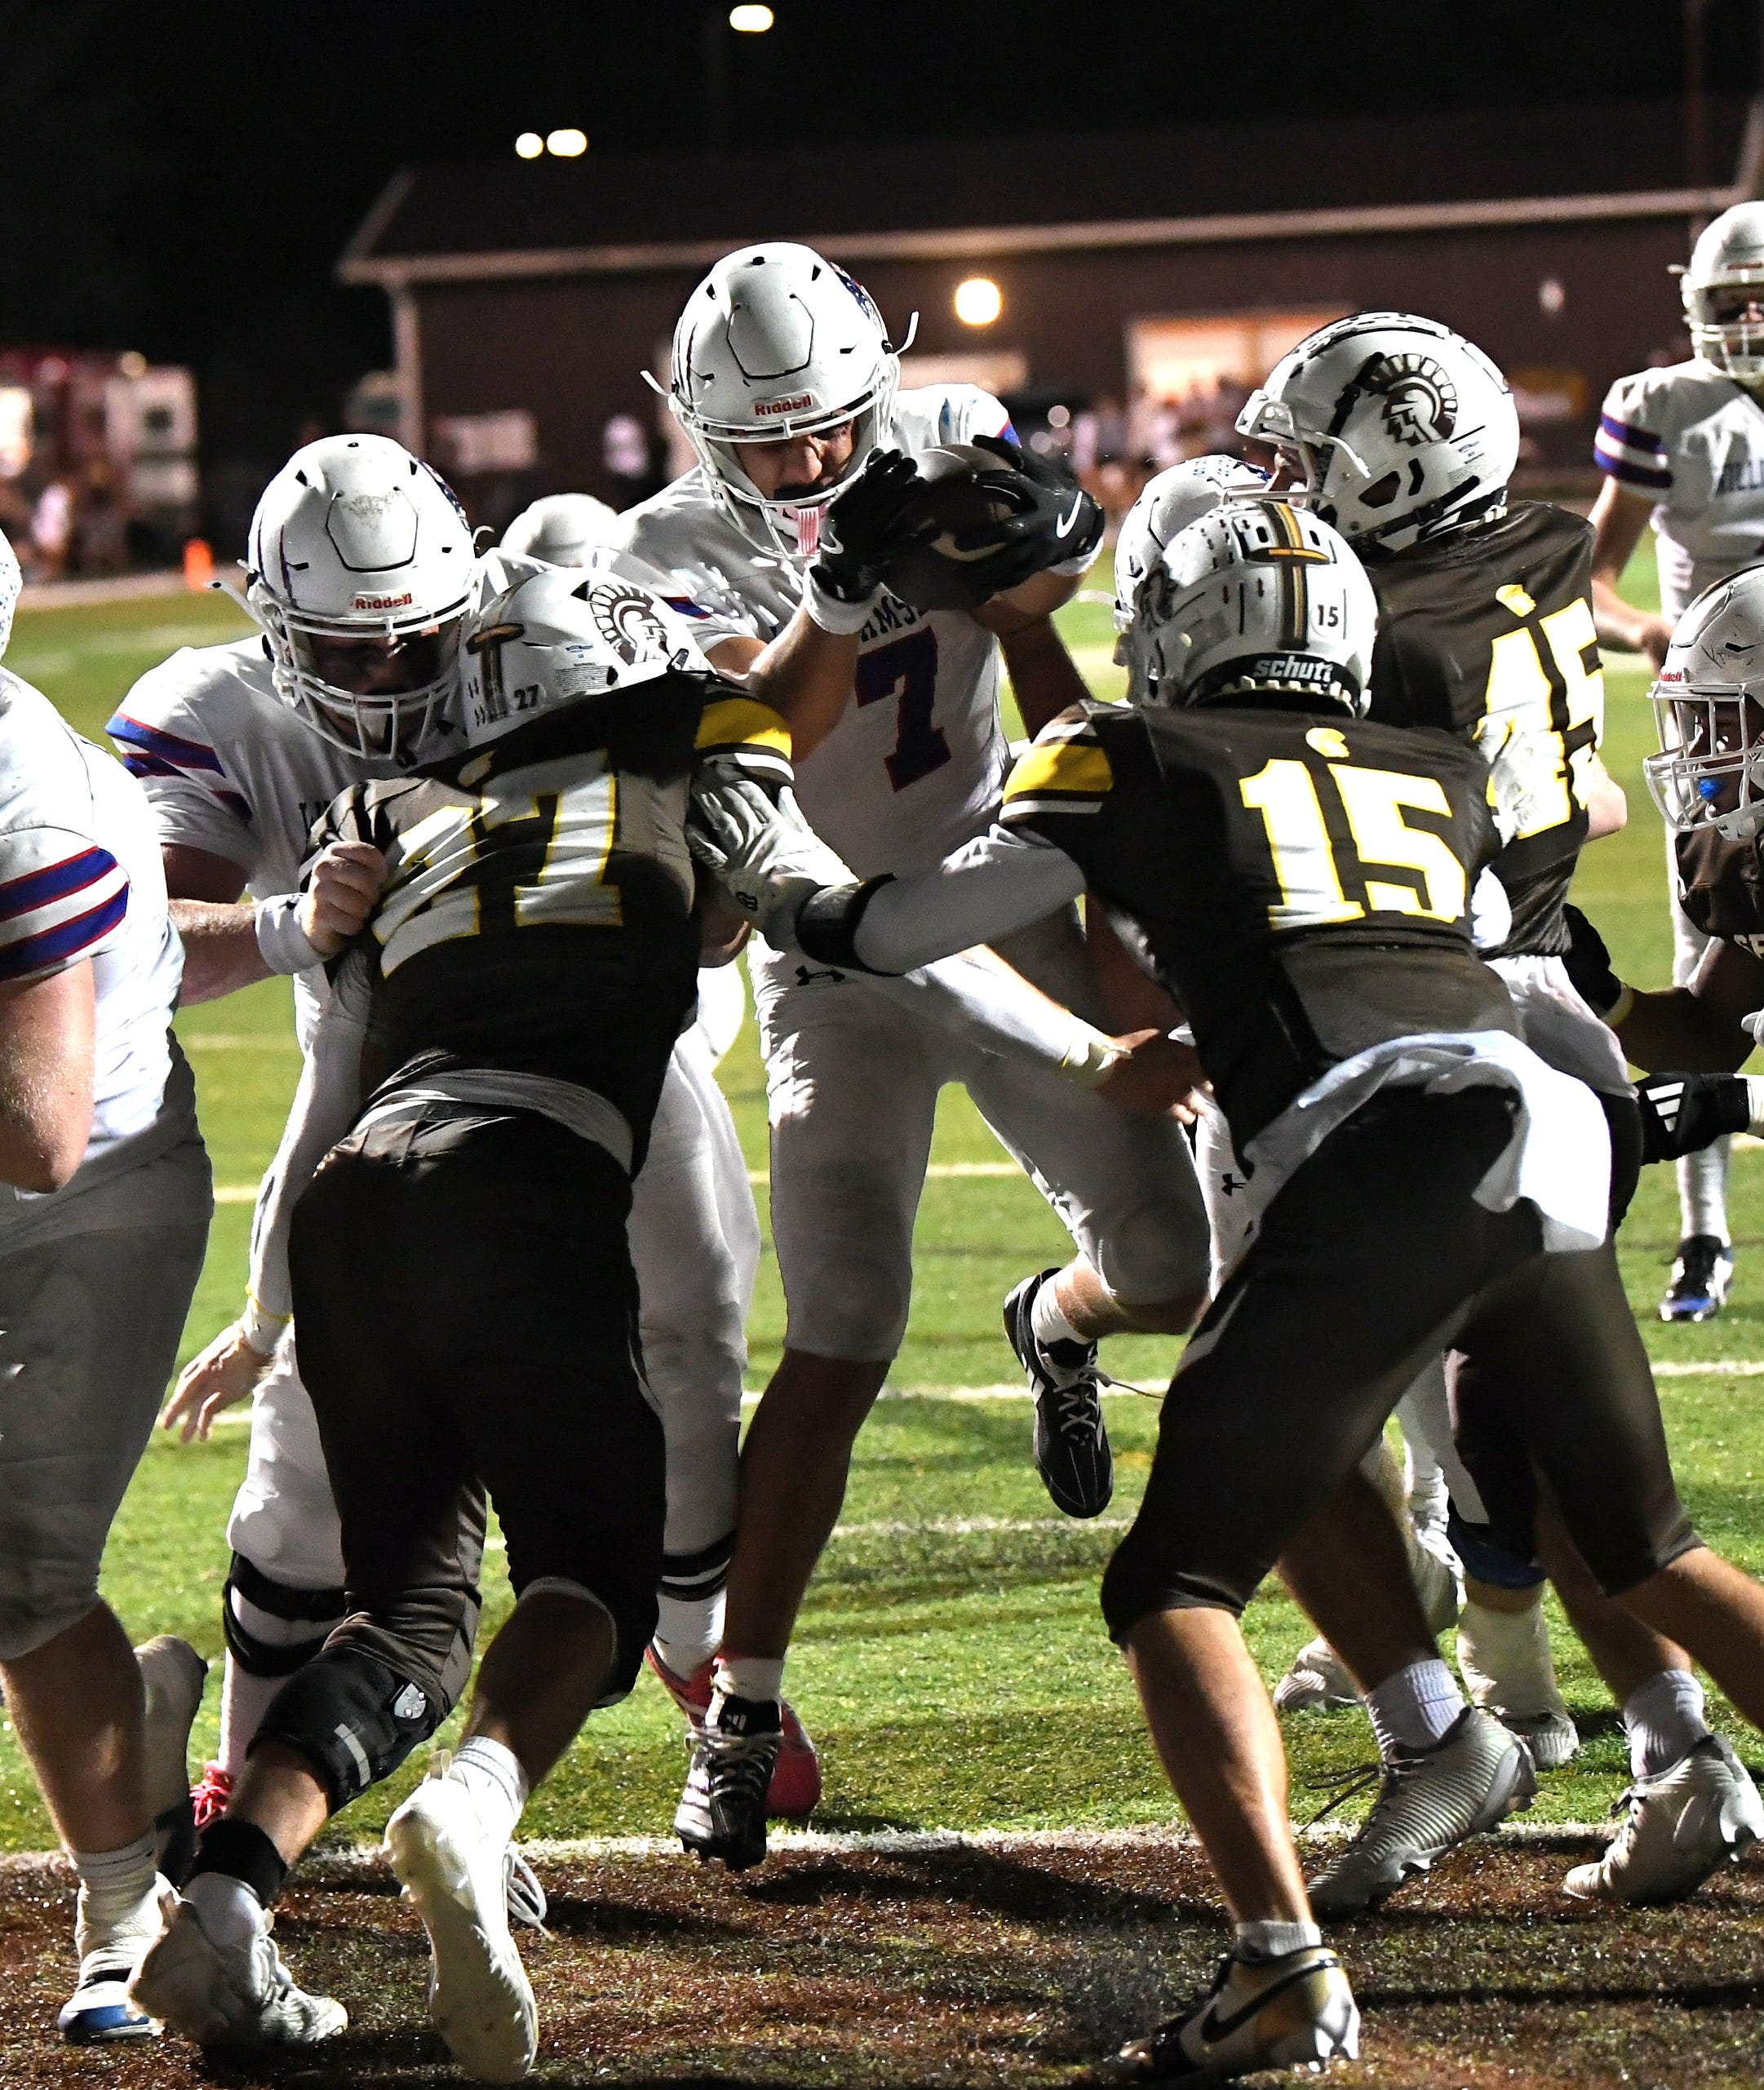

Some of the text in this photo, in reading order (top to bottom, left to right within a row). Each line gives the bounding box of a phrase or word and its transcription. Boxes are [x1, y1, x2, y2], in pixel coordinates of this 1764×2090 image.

[755, 393, 813, 416] Riddell
[355, 591, 413, 609] Riddell
[1317, 604, 1339, 627] 15
[1252, 655, 1333, 683] schutt
[514, 684, 539, 711] 27
[854, 624, 952, 793] 7
[1470, 596, 1605, 840] 45
[1239, 758, 1466, 930] 15
[372, 747, 623, 979] 27
